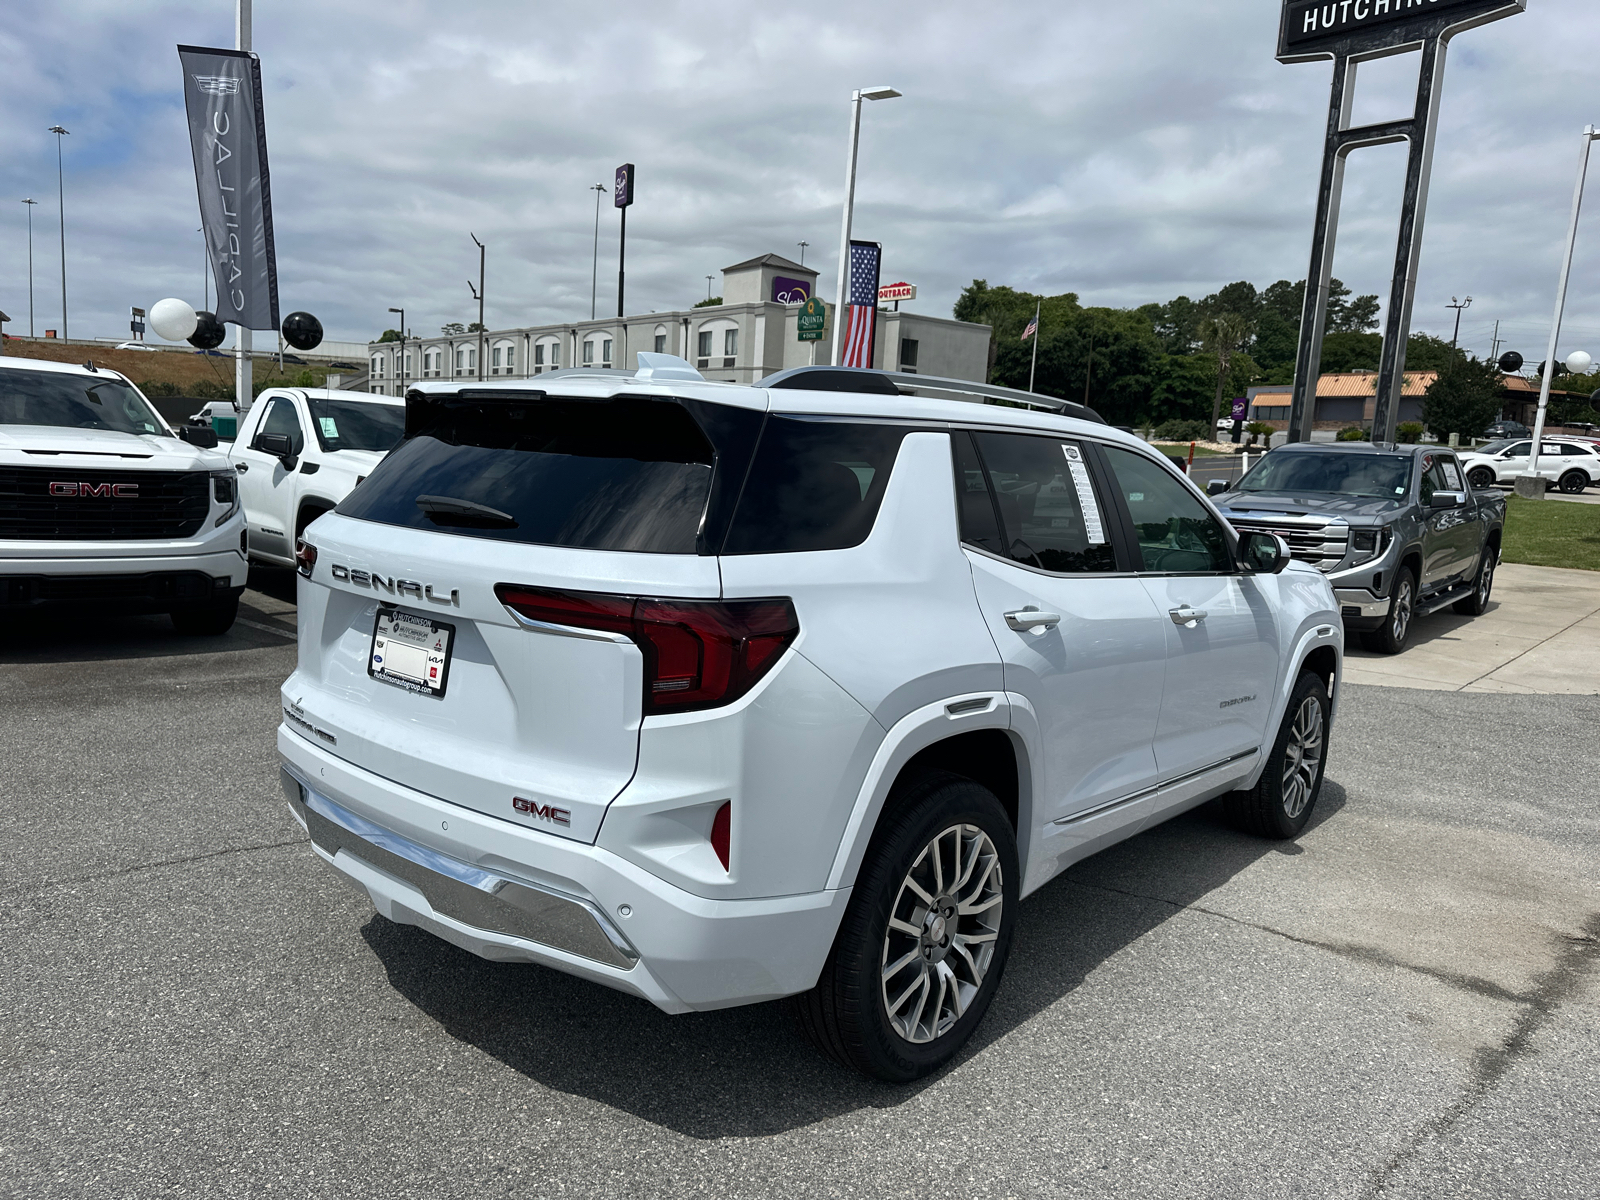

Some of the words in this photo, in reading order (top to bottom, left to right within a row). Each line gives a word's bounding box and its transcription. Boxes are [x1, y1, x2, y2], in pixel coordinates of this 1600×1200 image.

[1303, 0, 1438, 32] HUTCH
[878, 288, 911, 298] OUTBACK
[802, 315, 823, 326] QUINTA
[49, 481, 139, 498] GMC
[331, 562, 460, 608] DENALI
[398, 612, 432, 628] HUTCHINSON
[513, 796, 571, 824] GMC
